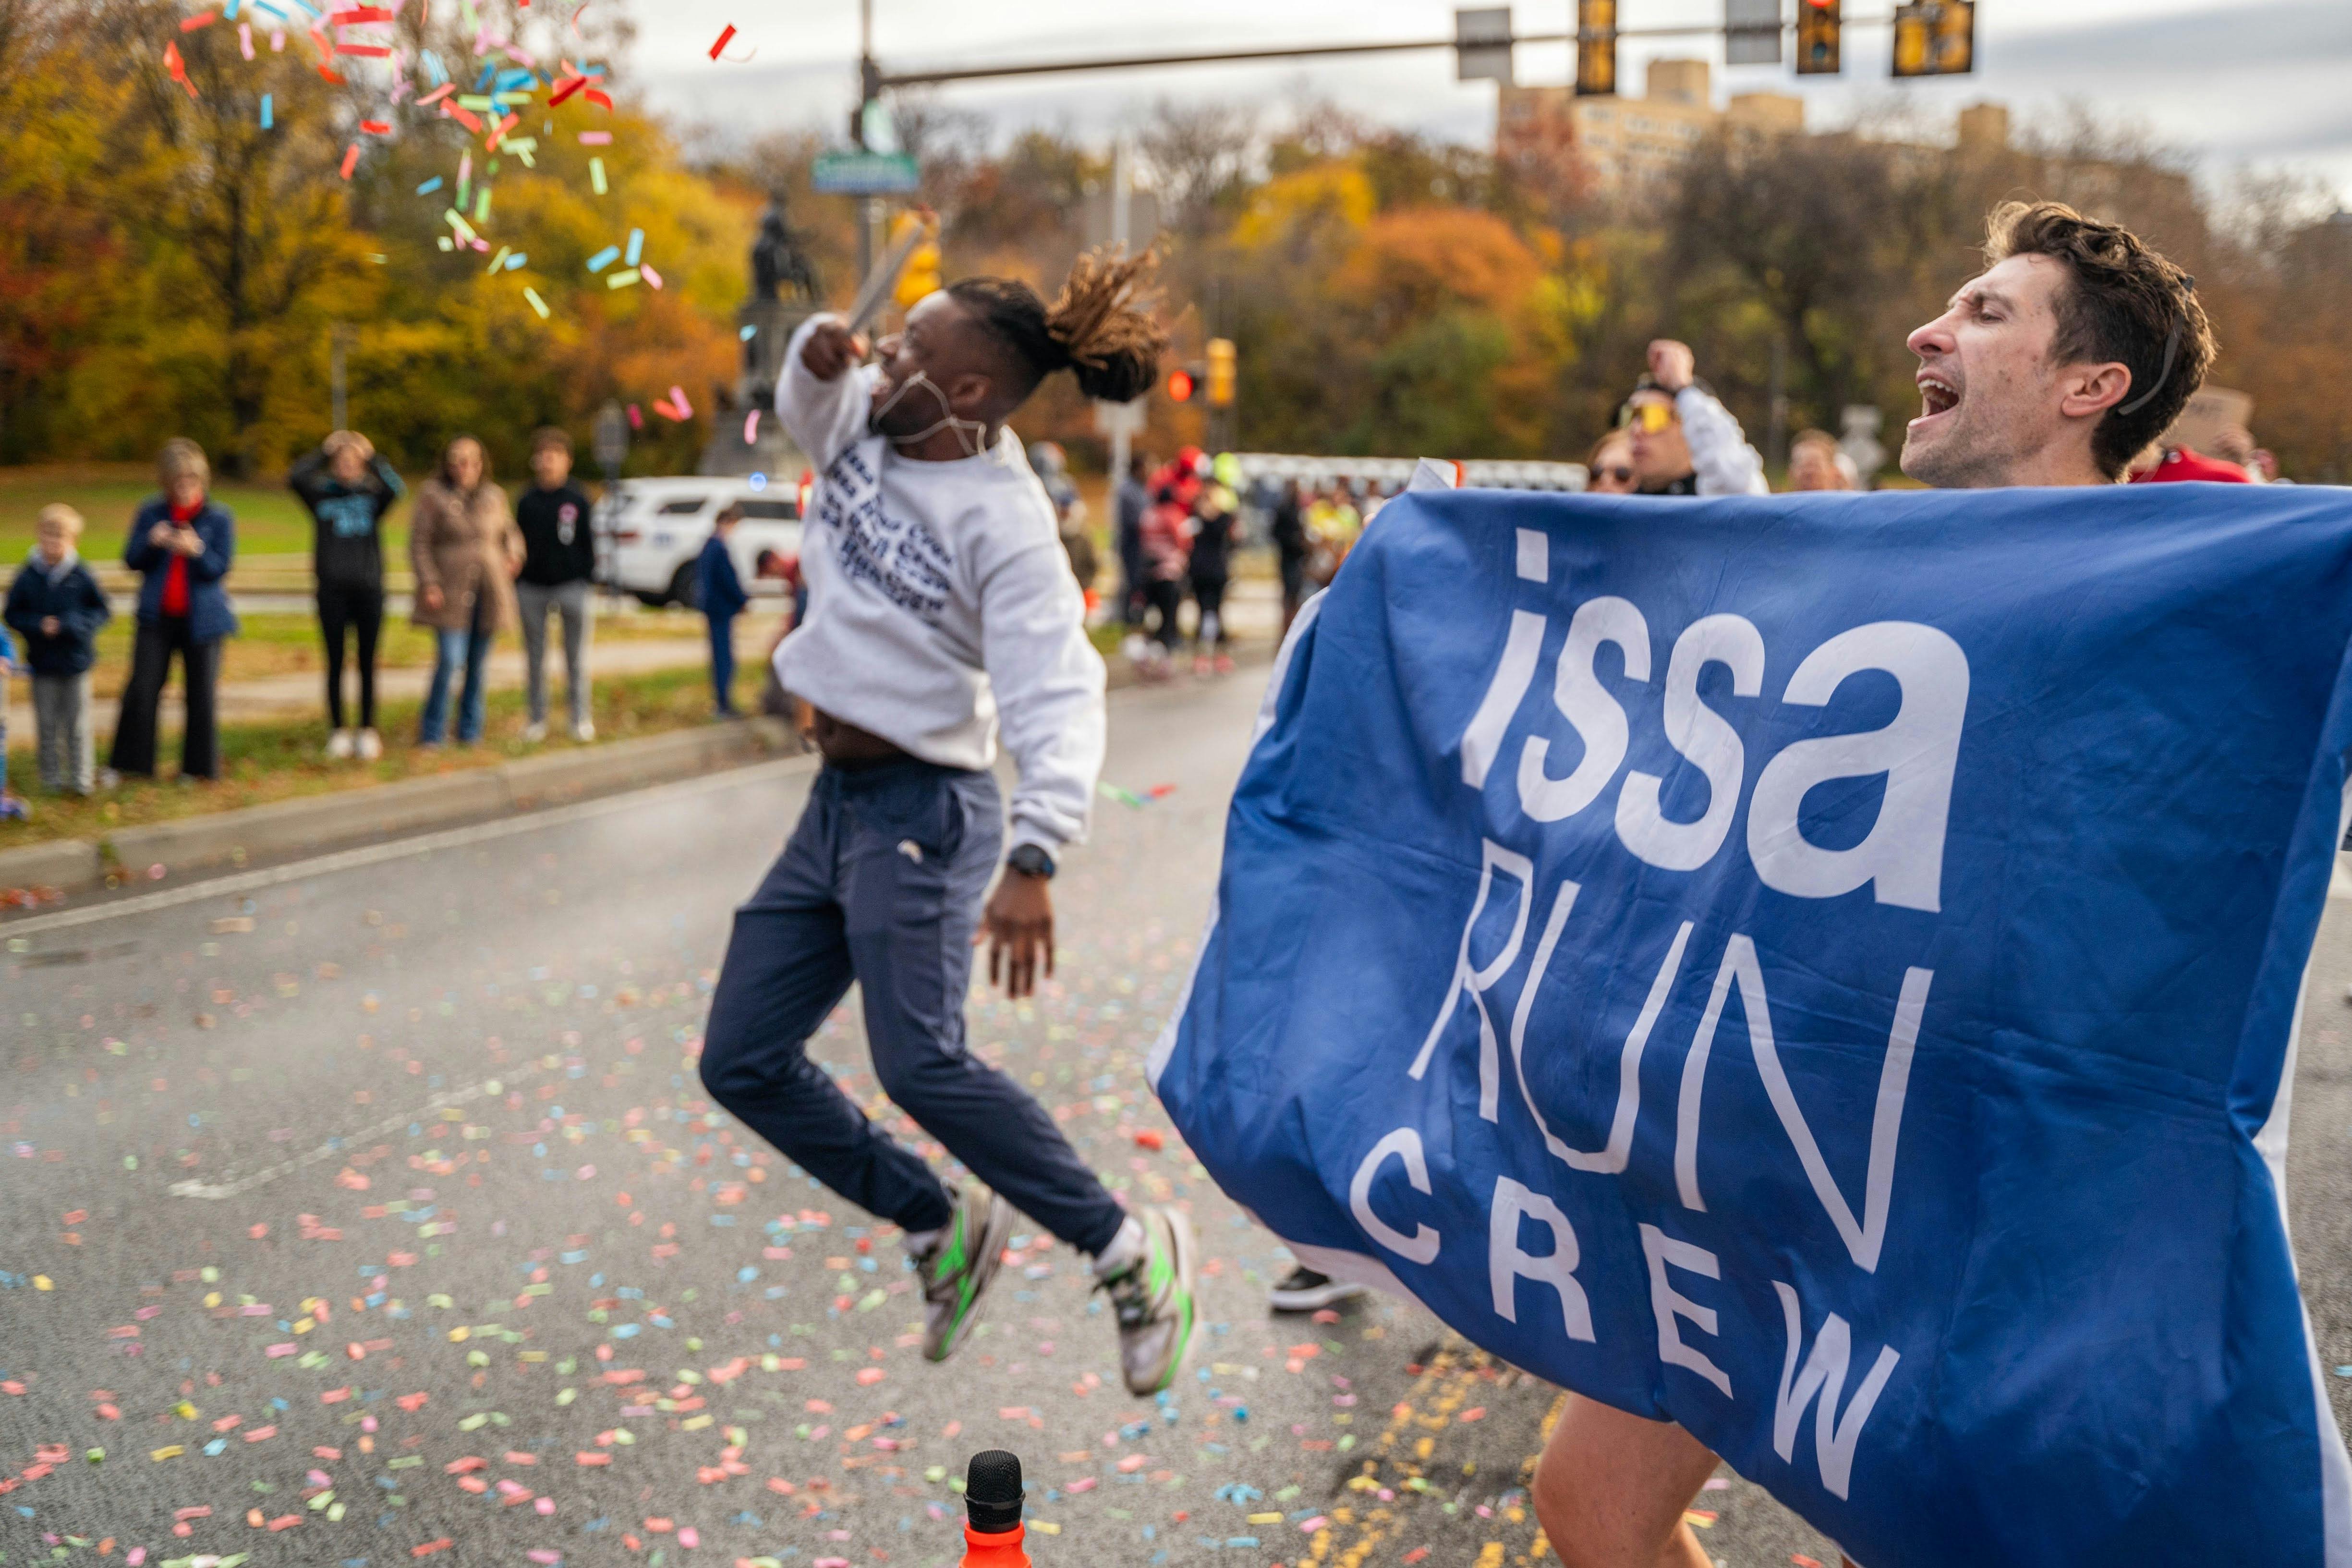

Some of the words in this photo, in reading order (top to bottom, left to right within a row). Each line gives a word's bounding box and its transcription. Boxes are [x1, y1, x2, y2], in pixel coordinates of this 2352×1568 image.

[1460, 528, 1970, 912] issa
[1407, 838, 1934, 1273] RUN
[1349, 1127, 1900, 1500] CREW
